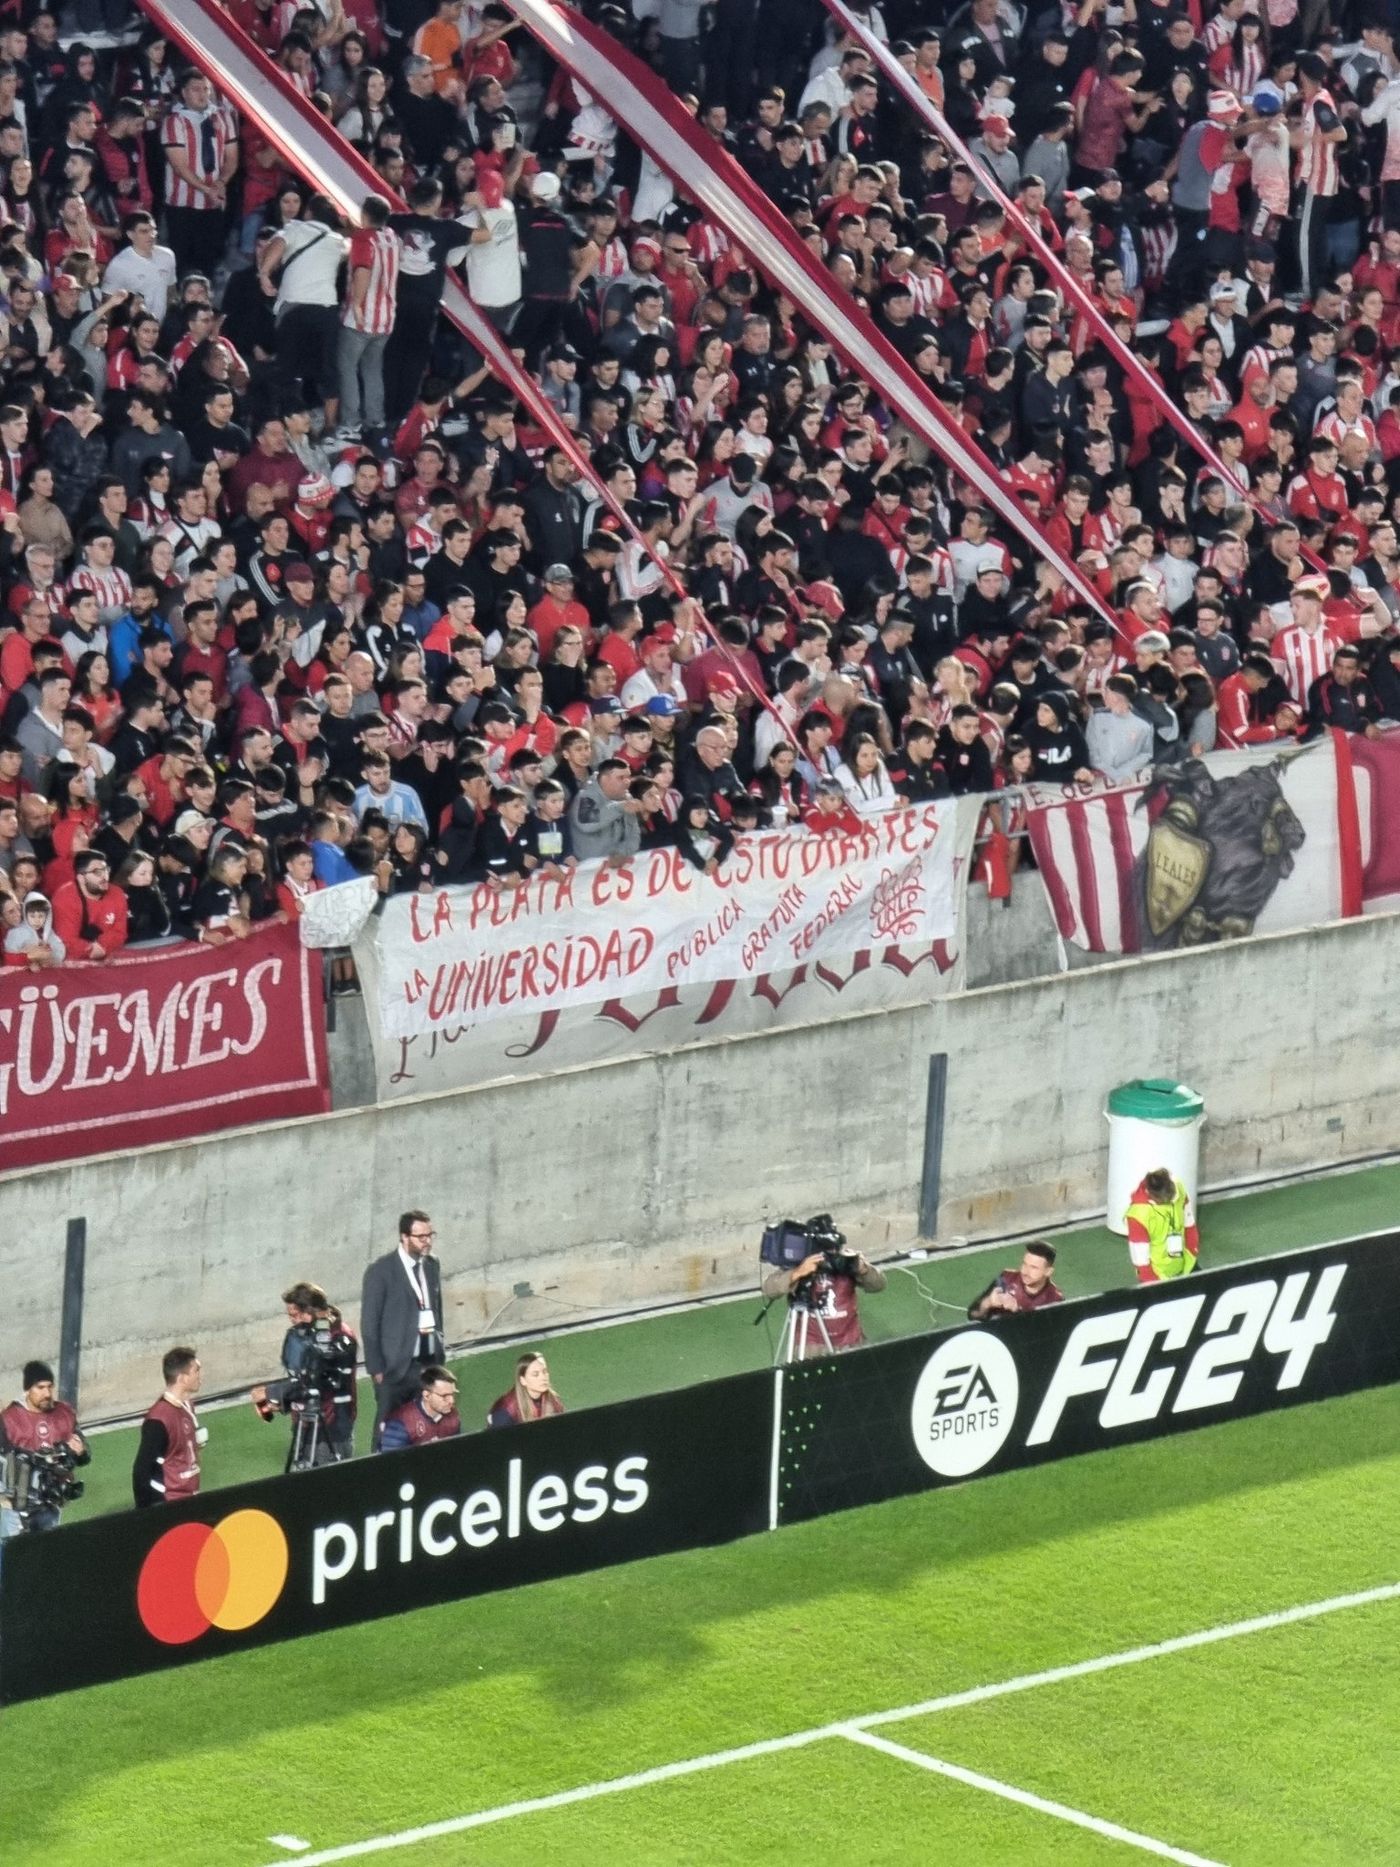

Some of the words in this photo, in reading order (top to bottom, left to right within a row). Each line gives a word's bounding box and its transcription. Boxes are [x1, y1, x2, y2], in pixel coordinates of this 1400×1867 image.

[410, 891, 453, 942] LA
[470, 865, 576, 930] PLATA
[592, 855, 634, 906] ES
[648, 848, 692, 897] DE
[1155, 852, 1196, 887] LEALES
[789, 873, 863, 960] FEDERAL
[404, 968, 430, 1004] LA
[932, 1362, 998, 1416] EA
[929, 1407, 1000, 1441] SPORTS
[312, 1456, 649, 1605] priceless
